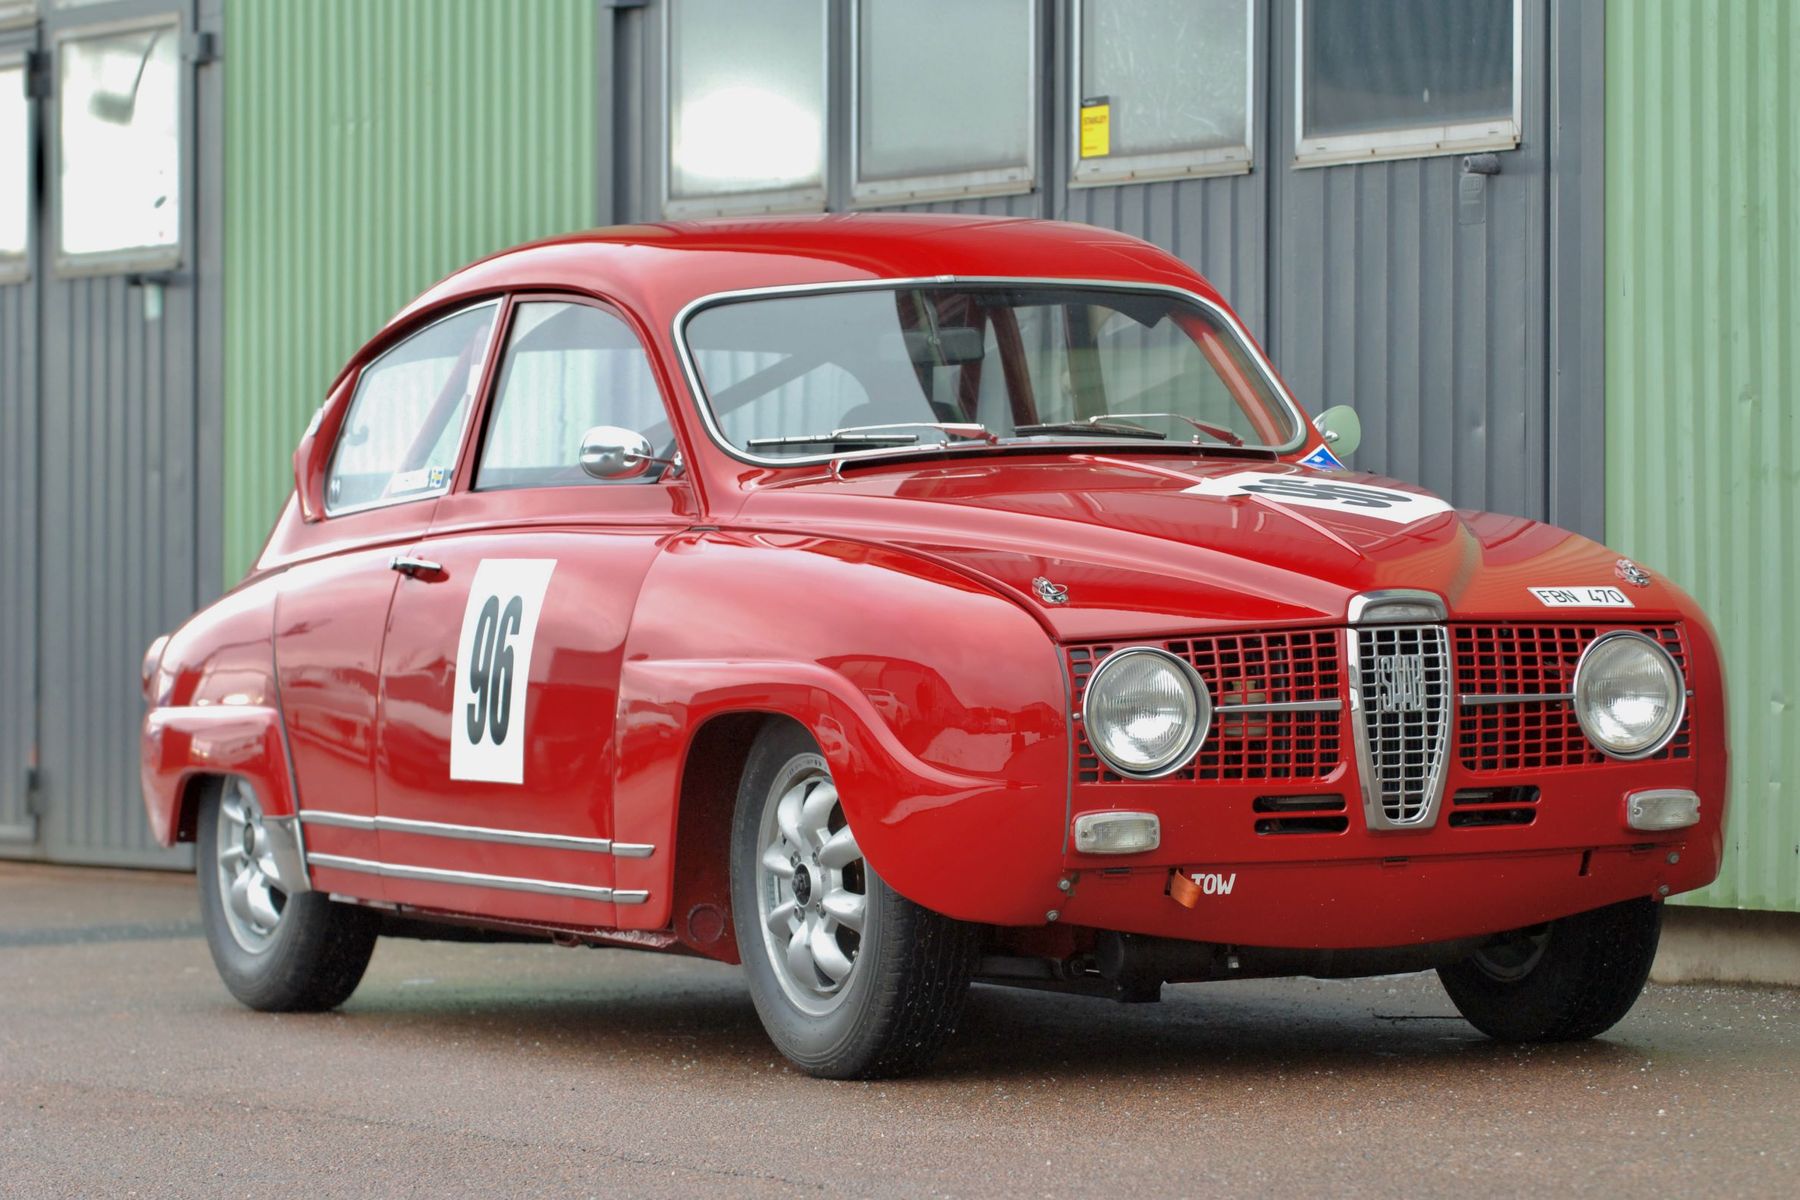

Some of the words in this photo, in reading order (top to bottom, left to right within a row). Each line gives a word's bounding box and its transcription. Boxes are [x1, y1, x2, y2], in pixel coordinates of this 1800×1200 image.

[1238, 478, 1413, 508] 96
[1536, 589, 1580, 603] FBN
[1587, 589, 1625, 603] 470
[466, 595, 523, 746] 96
[1379, 655, 1423, 712] SAAB
[1191, 873, 1236, 895] TOW
